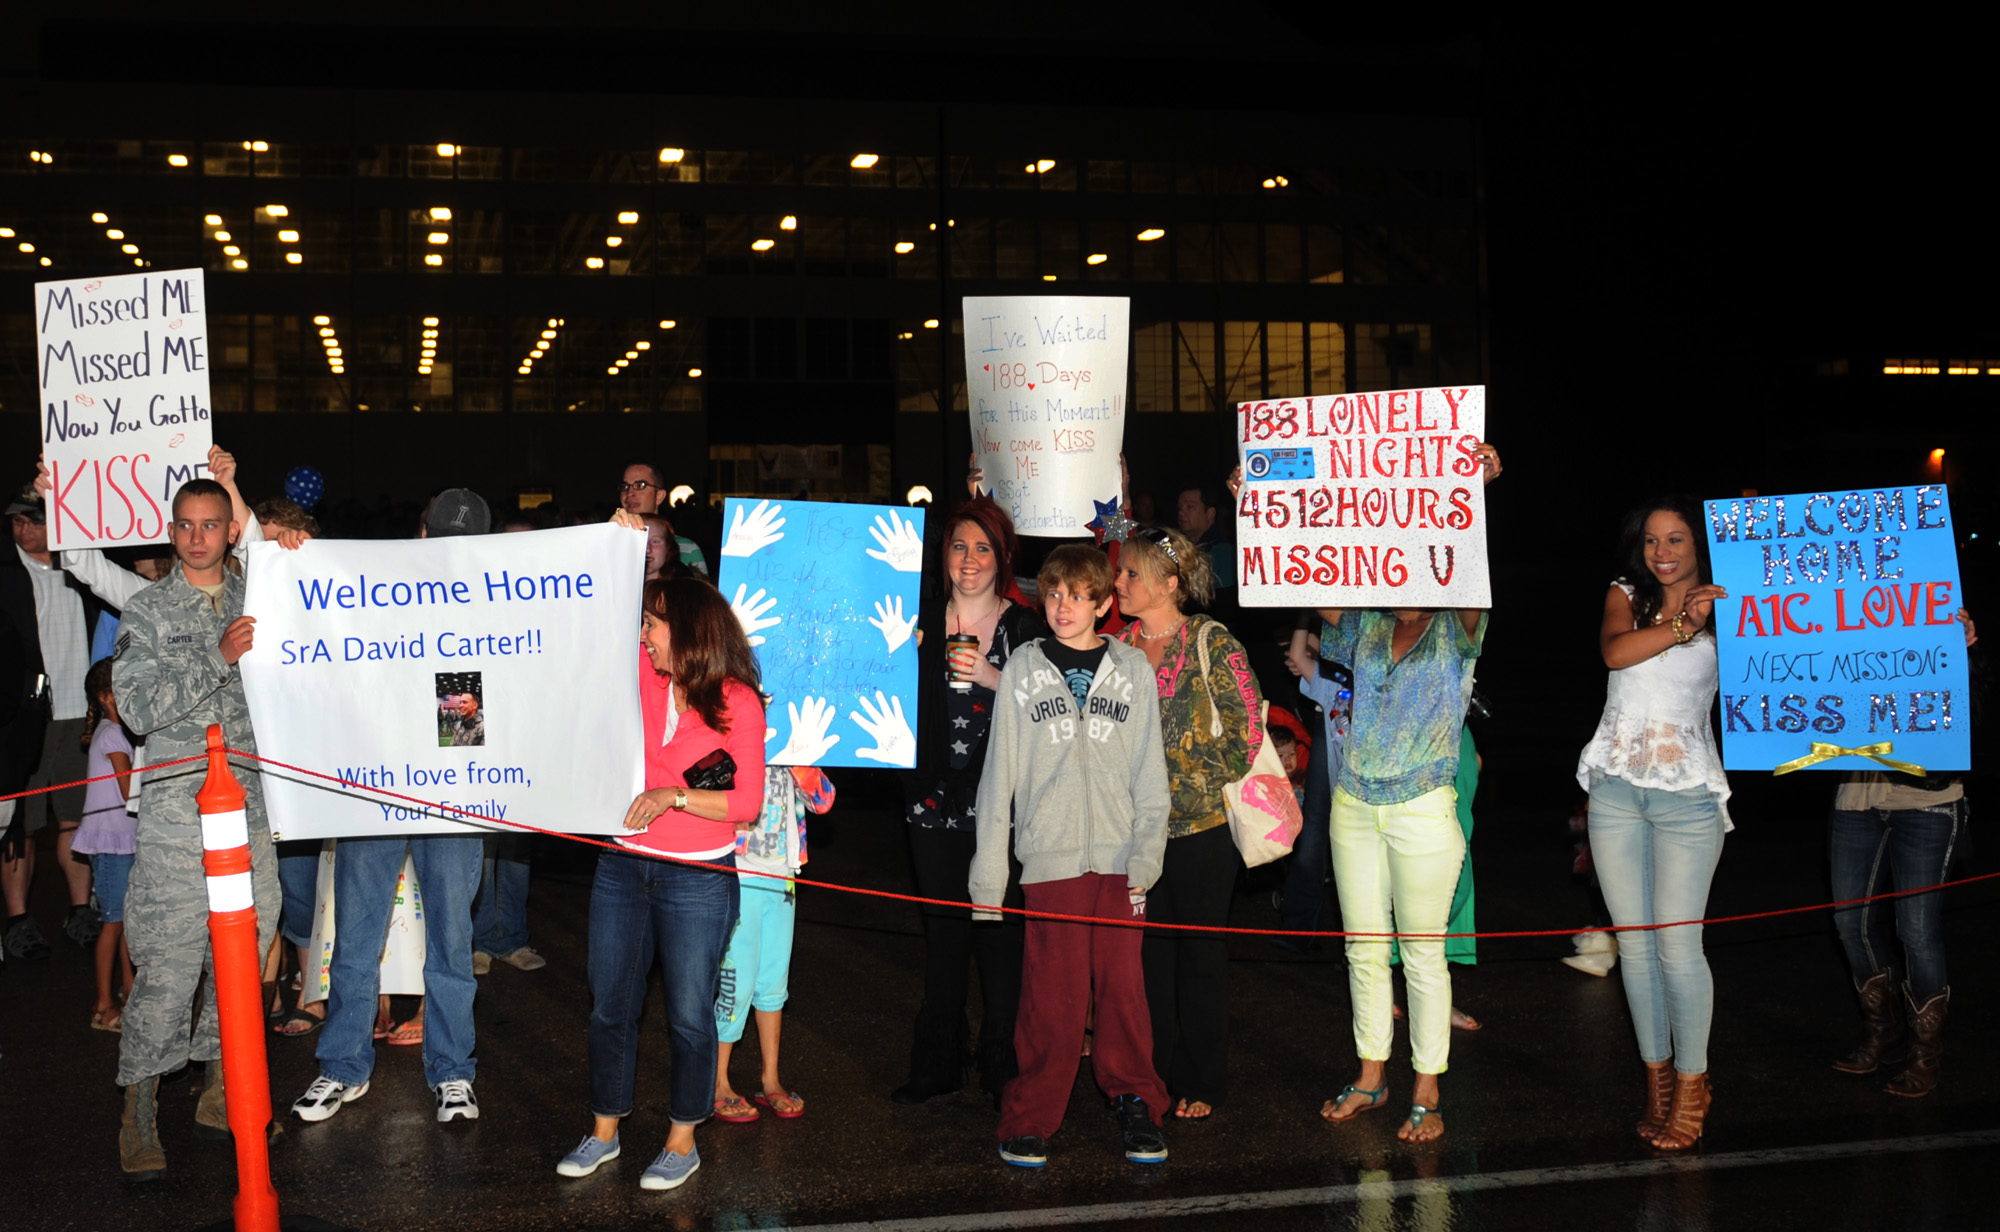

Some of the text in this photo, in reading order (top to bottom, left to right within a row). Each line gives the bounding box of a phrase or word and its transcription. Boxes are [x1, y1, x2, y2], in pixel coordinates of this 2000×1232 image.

[42, 277, 200, 333] Missed ME
[1034, 314, 1107, 345] Waited
[42, 330, 206, 389] Missed ME
[992, 361, 1092, 392] 188 Days
[45, 394, 209, 443] Now You Gotta
[1008, 400, 1038, 422] this
[1238, 388, 1470, 443] 188 LONELY
[1053, 428, 1096, 451] KISS
[1329, 434, 1482, 479] NIGHTS
[1015, 455, 1040, 480] ME
[52, 453, 163, 544] KISS
[1707, 485, 1946, 543] WELCOME
[1242, 543, 1455, 588] MISSING U
[1761, 535, 1904, 587] HOME
[298, 570, 594, 610] Welcome Home
[1735, 581, 1954, 638] A1C. LOVE
[167, 635, 193, 645] CARTER
[281, 629, 543, 665] SrA David Carter!!
[1741, 645, 1948, 684] NEXT MISSION:
[1089, 696, 1130, 723] BRAND
[1723, 689, 1953, 735] KISS ME!
[337, 761, 532, 789] With love from,
[380, 799, 507, 823] Your Family
[320, 942, 331, 993] KISSES
